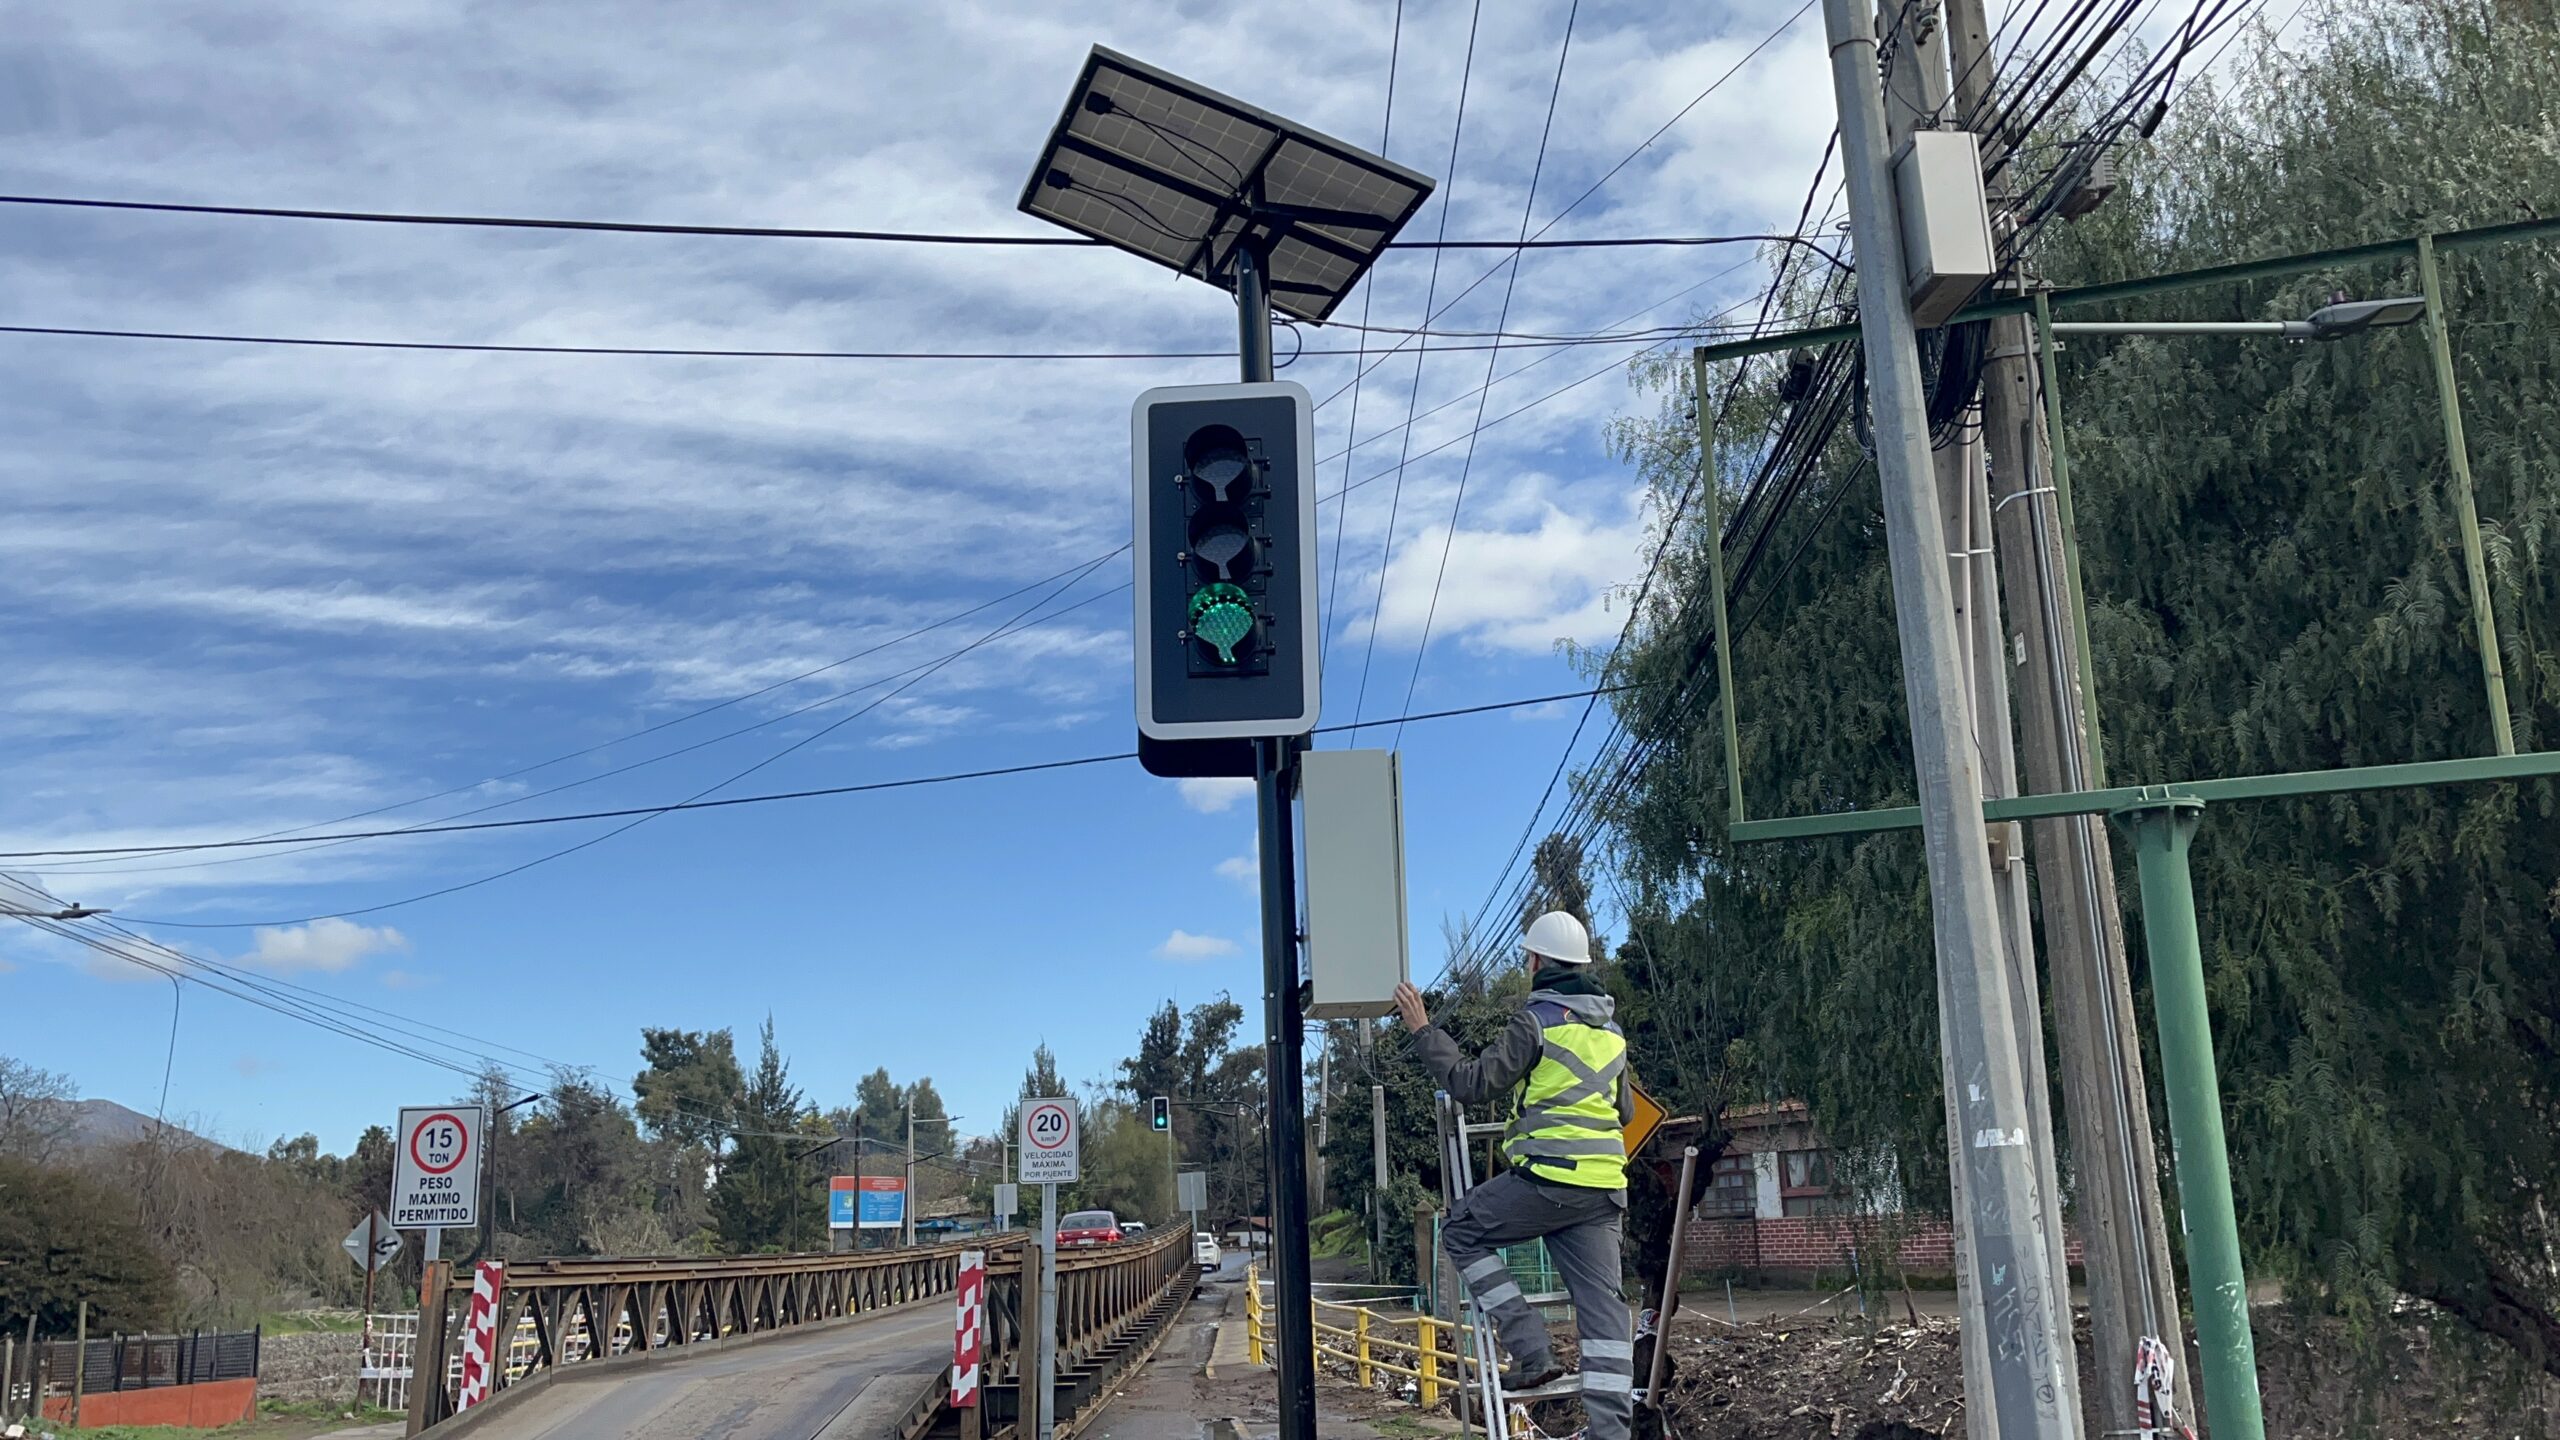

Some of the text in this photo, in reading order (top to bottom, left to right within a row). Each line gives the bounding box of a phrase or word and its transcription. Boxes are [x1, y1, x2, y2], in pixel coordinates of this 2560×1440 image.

[1037, 1114, 1062, 1132] 20
[426, 1128, 453, 1149] 15
[429, 1153, 450, 1163] TON
[1024, 1151, 1073, 1159] VELOCIDAD
[420, 1177, 452, 1189] PESO
[409, 1192, 460, 1205] MAXIMO
[399, 1208, 468, 1221] PERMITIDO
